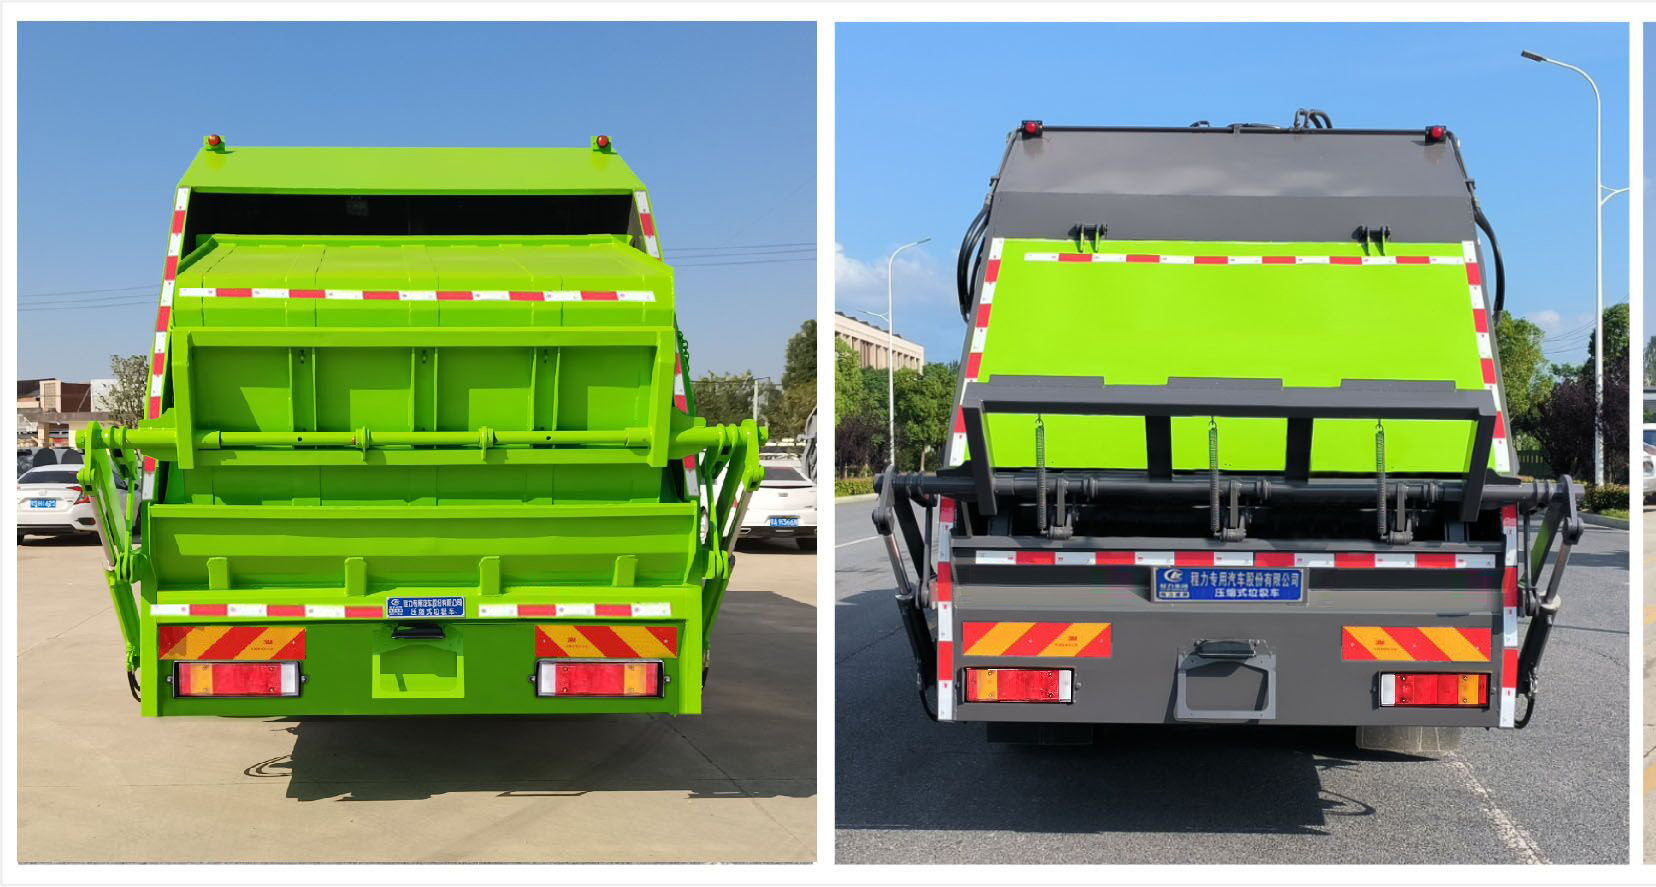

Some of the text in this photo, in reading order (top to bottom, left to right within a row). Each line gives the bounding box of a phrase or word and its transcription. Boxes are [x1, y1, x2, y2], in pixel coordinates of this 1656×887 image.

[1190, 571, 1299, 587] 程力专用汽车股份有限公司
